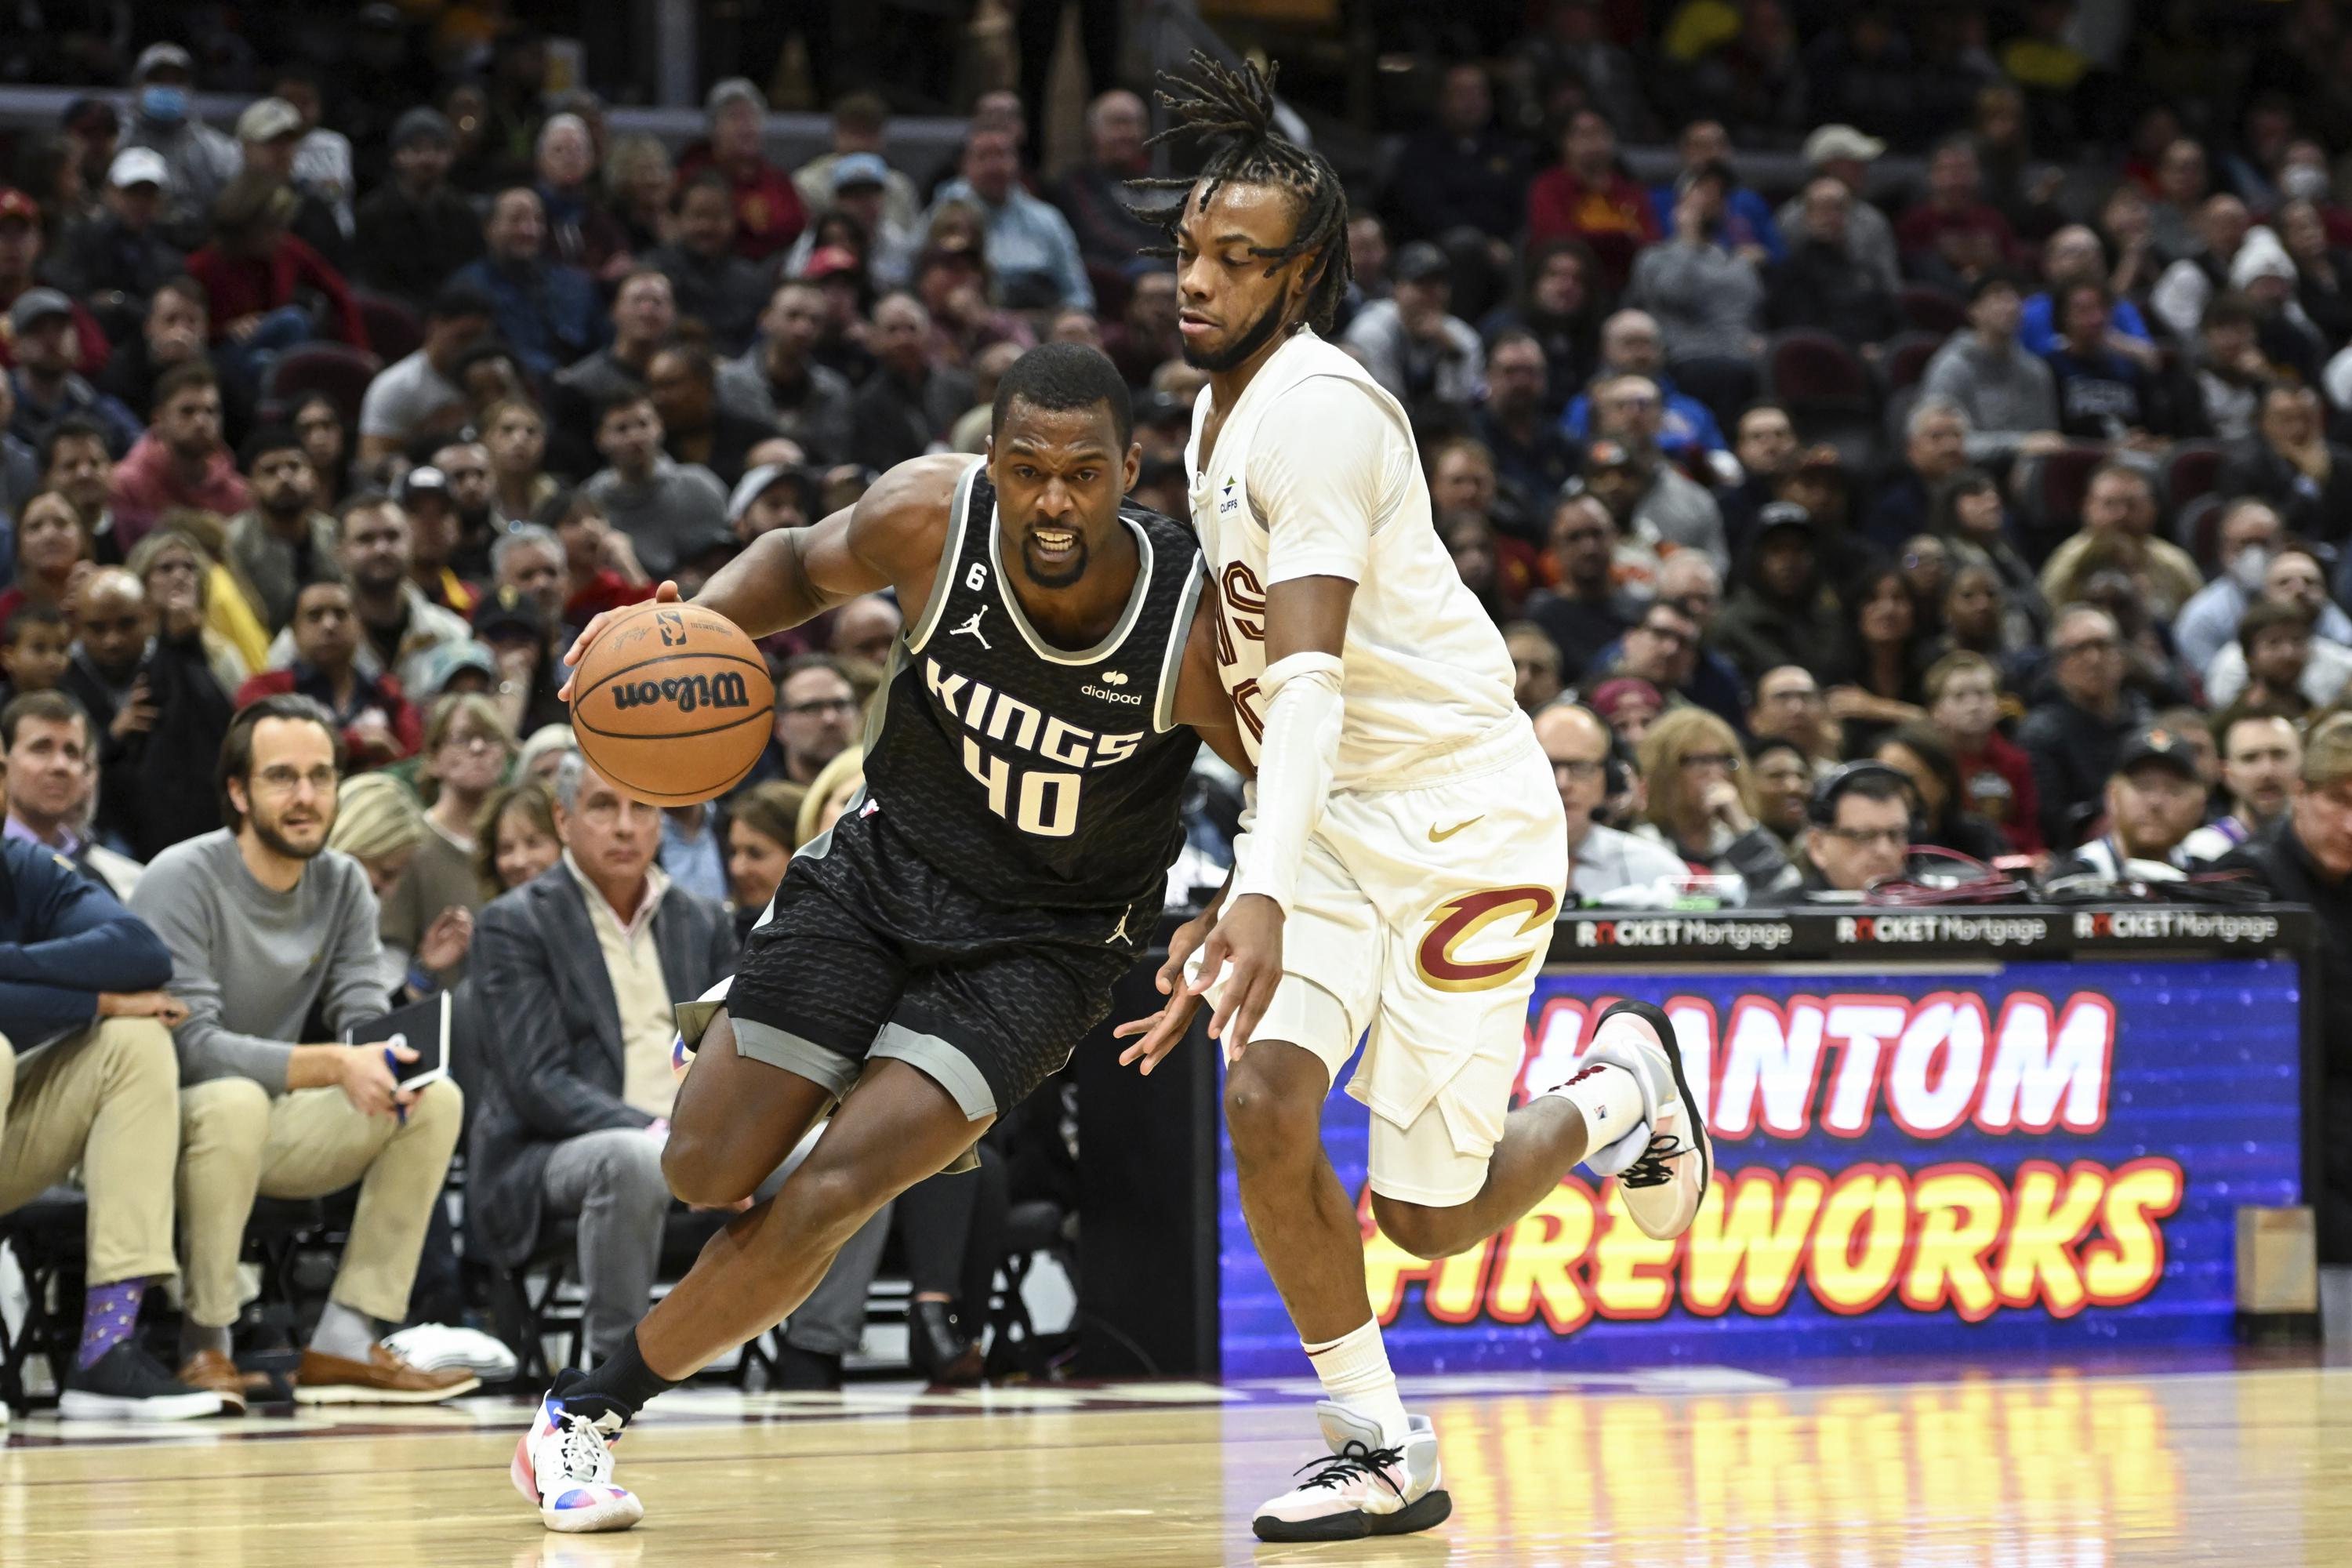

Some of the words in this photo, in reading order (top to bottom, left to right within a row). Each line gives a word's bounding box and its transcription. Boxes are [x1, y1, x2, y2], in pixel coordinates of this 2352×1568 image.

[1220, 498, 1238, 514] CLIFFS
[965, 561, 989, 591] 6
[612, 670, 750, 713] Wilson
[1081, 684, 1142, 706] dialpad
[926, 655, 1145, 768] KINGS
[963, 735, 1082, 837] 40
[1576, 920, 1679, 947] ROCKET
[1682, 919, 1793, 950] Mortgage
[1835, 915, 1937, 942] ROCKET
[1939, 915, 2048, 946] Mortgage
[2072, 911, 2172, 938] ROCKET
[2172, 911, 2279, 942] Mortgage
